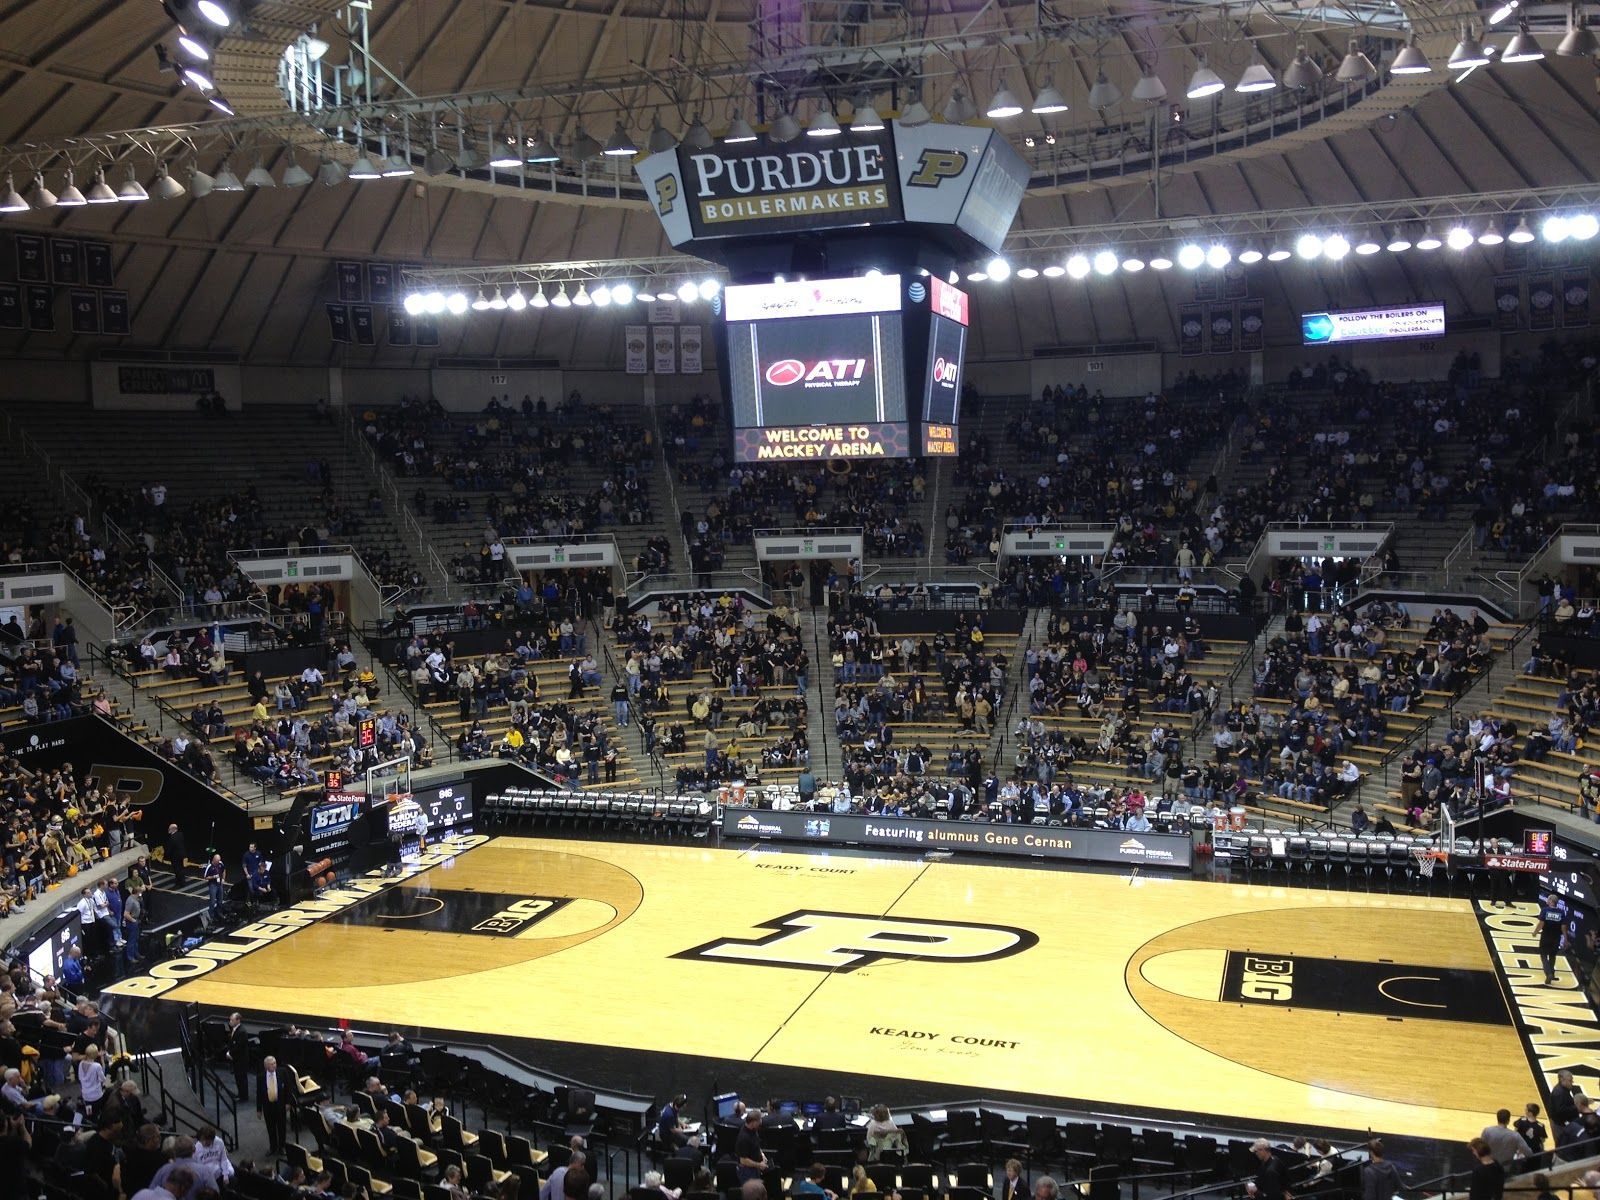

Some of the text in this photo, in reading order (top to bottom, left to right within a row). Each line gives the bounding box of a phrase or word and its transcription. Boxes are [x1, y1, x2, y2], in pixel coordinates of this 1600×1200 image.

[690, 144, 884, 197] PURDUE
[906, 148, 968, 189] P
[655, 172, 678, 217] P
[705, 188, 886, 219] BOILERMAKERS
[1385, 311, 1414, 319] BOILERS
[804, 359, 866, 381] ATI
[942, 362, 958, 382] ATI
[1090, 362, 1104, 370] 101
[490, 375, 506, 384] 117
[765, 427, 870, 443] WELCOME TO
[758, 442, 885, 459] MACKEY ARENA
[362, 730, 372, 745] 35
[35, 743, 49, 751] PLAY
[315, 804, 353, 829] BTN
[388, 810, 419, 824] PURDU
[389, 817, 417, 831] FEDERA
[865, 824, 1072, 849] Featuring alumnus Gene Cernan
[1531, 833, 1549, 841] 8:16
[1531, 841, 1546, 852] 35
[755, 863, 804, 871] KEADY
[666, 908, 1040, 975] P
[870, 1027, 1021, 1049] KEADY COURT
